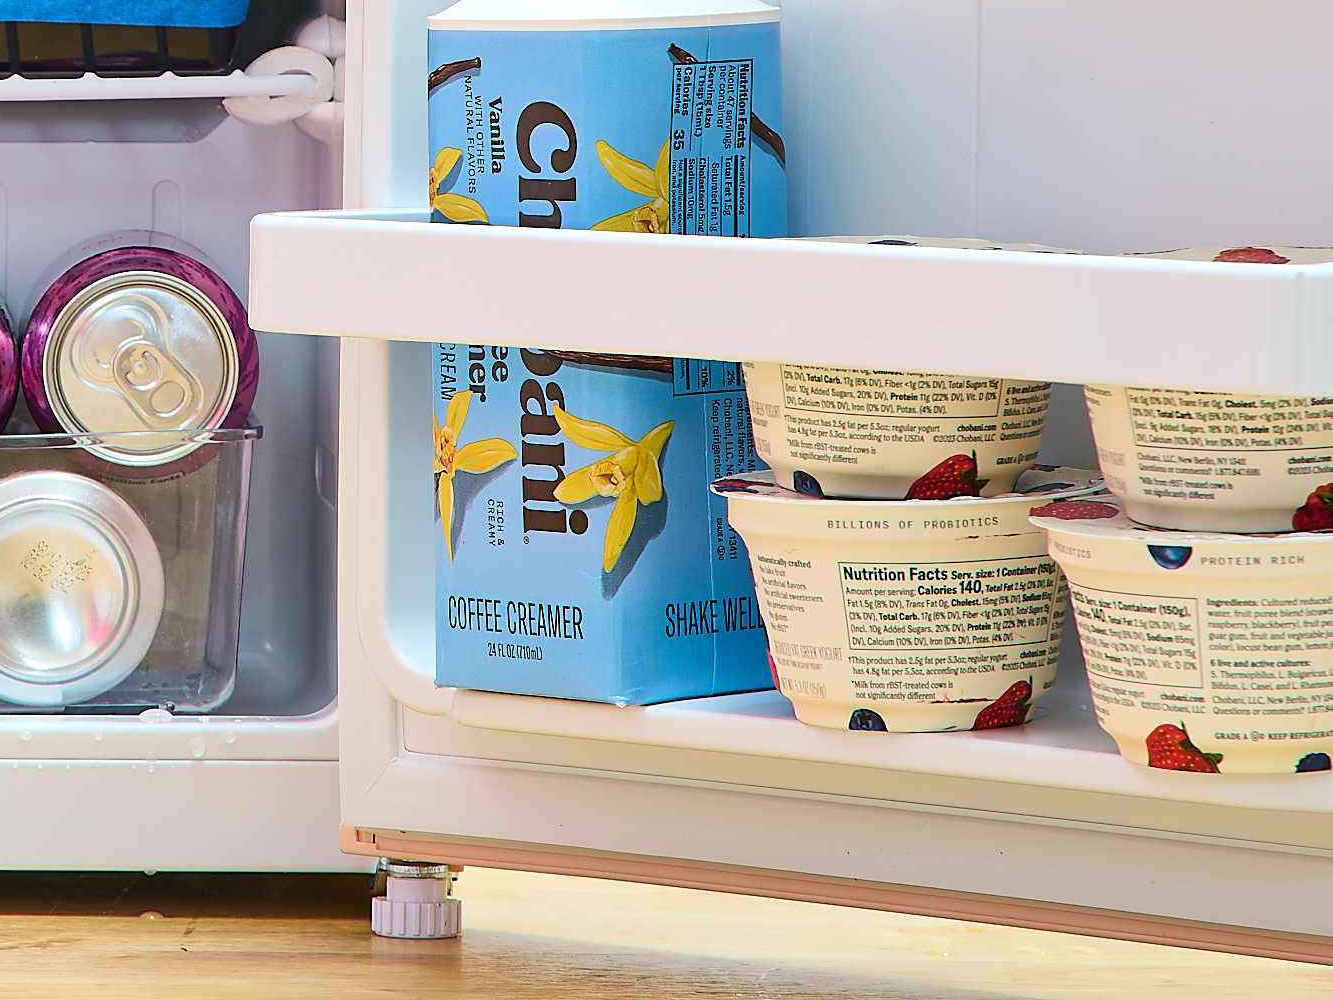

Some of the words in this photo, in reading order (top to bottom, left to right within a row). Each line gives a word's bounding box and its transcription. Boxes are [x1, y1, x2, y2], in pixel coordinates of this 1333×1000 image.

[674, 67, 683, 81] per
[705, 65, 717, 106] Serving
[718, 65, 726, 80] per
[727, 65, 737, 93] About
[673, 83, 682, 115] serving
[681, 67, 693, 117] Calories
[695, 74, 707, 100] Tbsp
[738, 63, 750, 116] Nutrition
[464, 75, 475, 131] NATURAL
[475, 95, 484, 127] WITH
[716, 81, 726, 129] container
[726, 95, 735, 107] 47
[704, 108, 714, 129] size
[724, 110, 734, 150] servings
[489, 96, 505, 174] Vanilla
[673, 129, 685, 151] 35
[736, 118, 748, 149] Facts
[468, 138, 476, 194] FLAVORS
[476, 132, 484, 174] OTHER
[687, 158, 696, 194] Sodium
[724, 156, 733, 180] Total
[697, 157, 707, 212] Cholesterol
[710, 162, 720, 205] Saturated
[724, 181, 733, 197] Fat
[722, 198, 733, 216] 1.5g
[701, 367, 709, 388] 10%
[725, 369, 736, 385] 2%
[806, 373, 823, 383] Total
[824, 375, 842, 385] Carb.
[890, 392, 918, 402] Protein
[711, 399, 721, 423] Keep
[723, 397, 733, 437] Chobani,
[736, 397, 745, 429] natural
[711, 424, 723, 480] refrigerated
[724, 439, 734, 464] LLC,
[487, 498, 497, 546] CREAMY
[496, 500, 504, 533] RICH
[827, 520, 890, 529] BILLIONS
[899, 520, 914, 529] OF
[924, 516, 999, 529] PROBIOTICS
[497, 537, 505, 546] &
[729, 534, 738, 560] 13411
[843, 566, 905, 581] Nutrition
[909, 566, 948, 581] Facts
[951, 570, 974, 580] Serv.
[975, 568, 995, 579] size:
[1001, 565, 1037, 577] Container
[1201, 556, 1261, 566] PROTEIN
[1271, 555, 1305, 565] RICH
[846, 586, 873, 596] Amount
[918, 585, 957, 596] Calories
[986, 584, 1003, 594] Total
[1003, 582, 1014, 592] Fat
[448, 595, 502, 632] COFFEE
[507, 600, 584, 639] CREAMER
[665, 600, 719, 638] SHAKE
[878, 612, 898, 621] Total
[899, 612, 920, 621] Carb.
[967, 622, 992, 632] Protein
[487, 642, 497, 657] 24
[498, 643, 506, 658] FL
[506, 643, 516, 659] OZ
[516, 644, 543, 661] (710mL)
